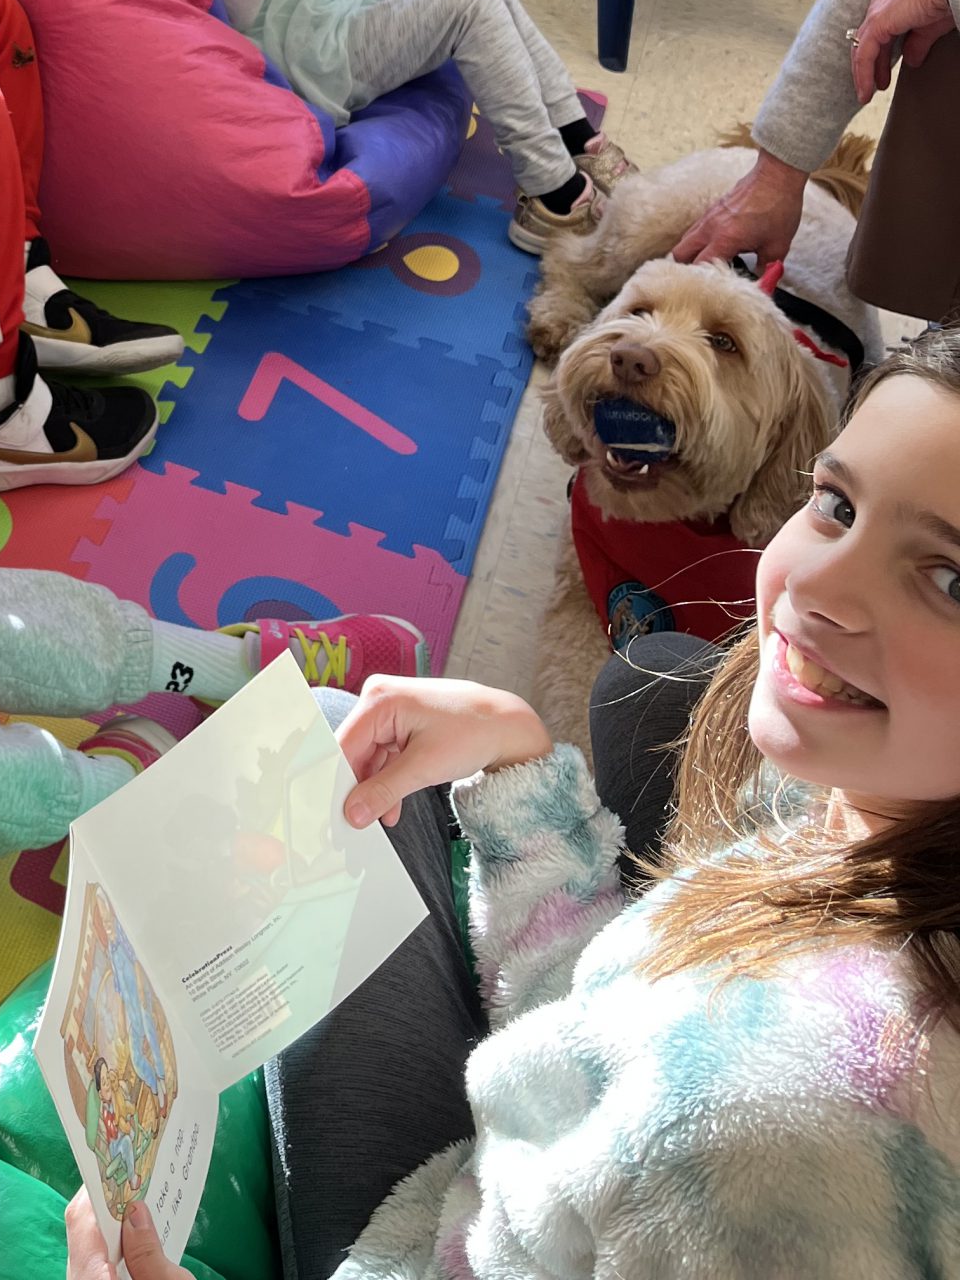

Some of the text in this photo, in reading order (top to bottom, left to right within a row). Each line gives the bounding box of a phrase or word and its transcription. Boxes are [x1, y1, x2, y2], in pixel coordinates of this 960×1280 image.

[237, 351, 418, 456] 7
[165, 661, 195, 694] 23
[181, 945, 233, 984] CelebrationPress
[156, 1180, 169, 1214] take
[160, 1220, 172, 1247] ust
[171, 1188, 183, 1216] like
